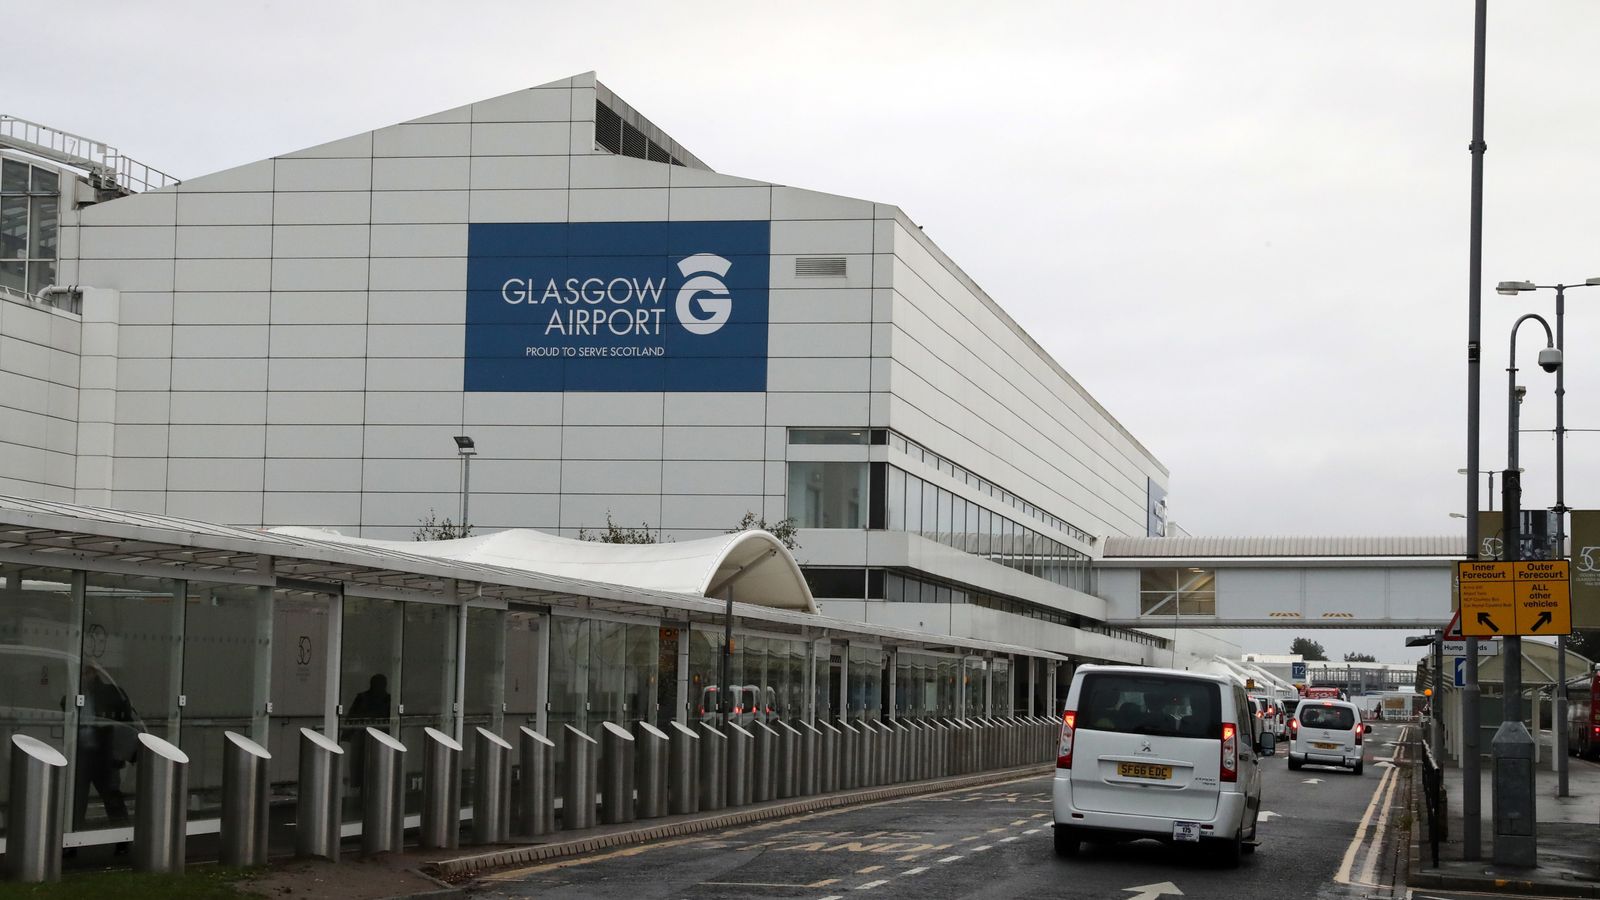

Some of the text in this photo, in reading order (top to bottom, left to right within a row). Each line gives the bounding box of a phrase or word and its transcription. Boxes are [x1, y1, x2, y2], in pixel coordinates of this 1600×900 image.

[501, 277, 666, 305] GLASGOW
[544, 308, 666, 335] AIRPORT
[526, 346, 665, 357] PROUD TO SERVE SCOTLAND
[1472, 563, 1495, 571] Inner
[1527, 563, 1554, 571] Outer
[1462, 571, 1506, 579] Forecourt
[1518, 570, 1564, 579] Forecourt
[1529, 592, 1551, 600] other
[1523, 600, 1558, 608] vehicles
[1444, 644, 1464, 652] Hump
[1294, 666, 1305, 675] T2
[1121, 764, 1168, 776] SF66 EDC
